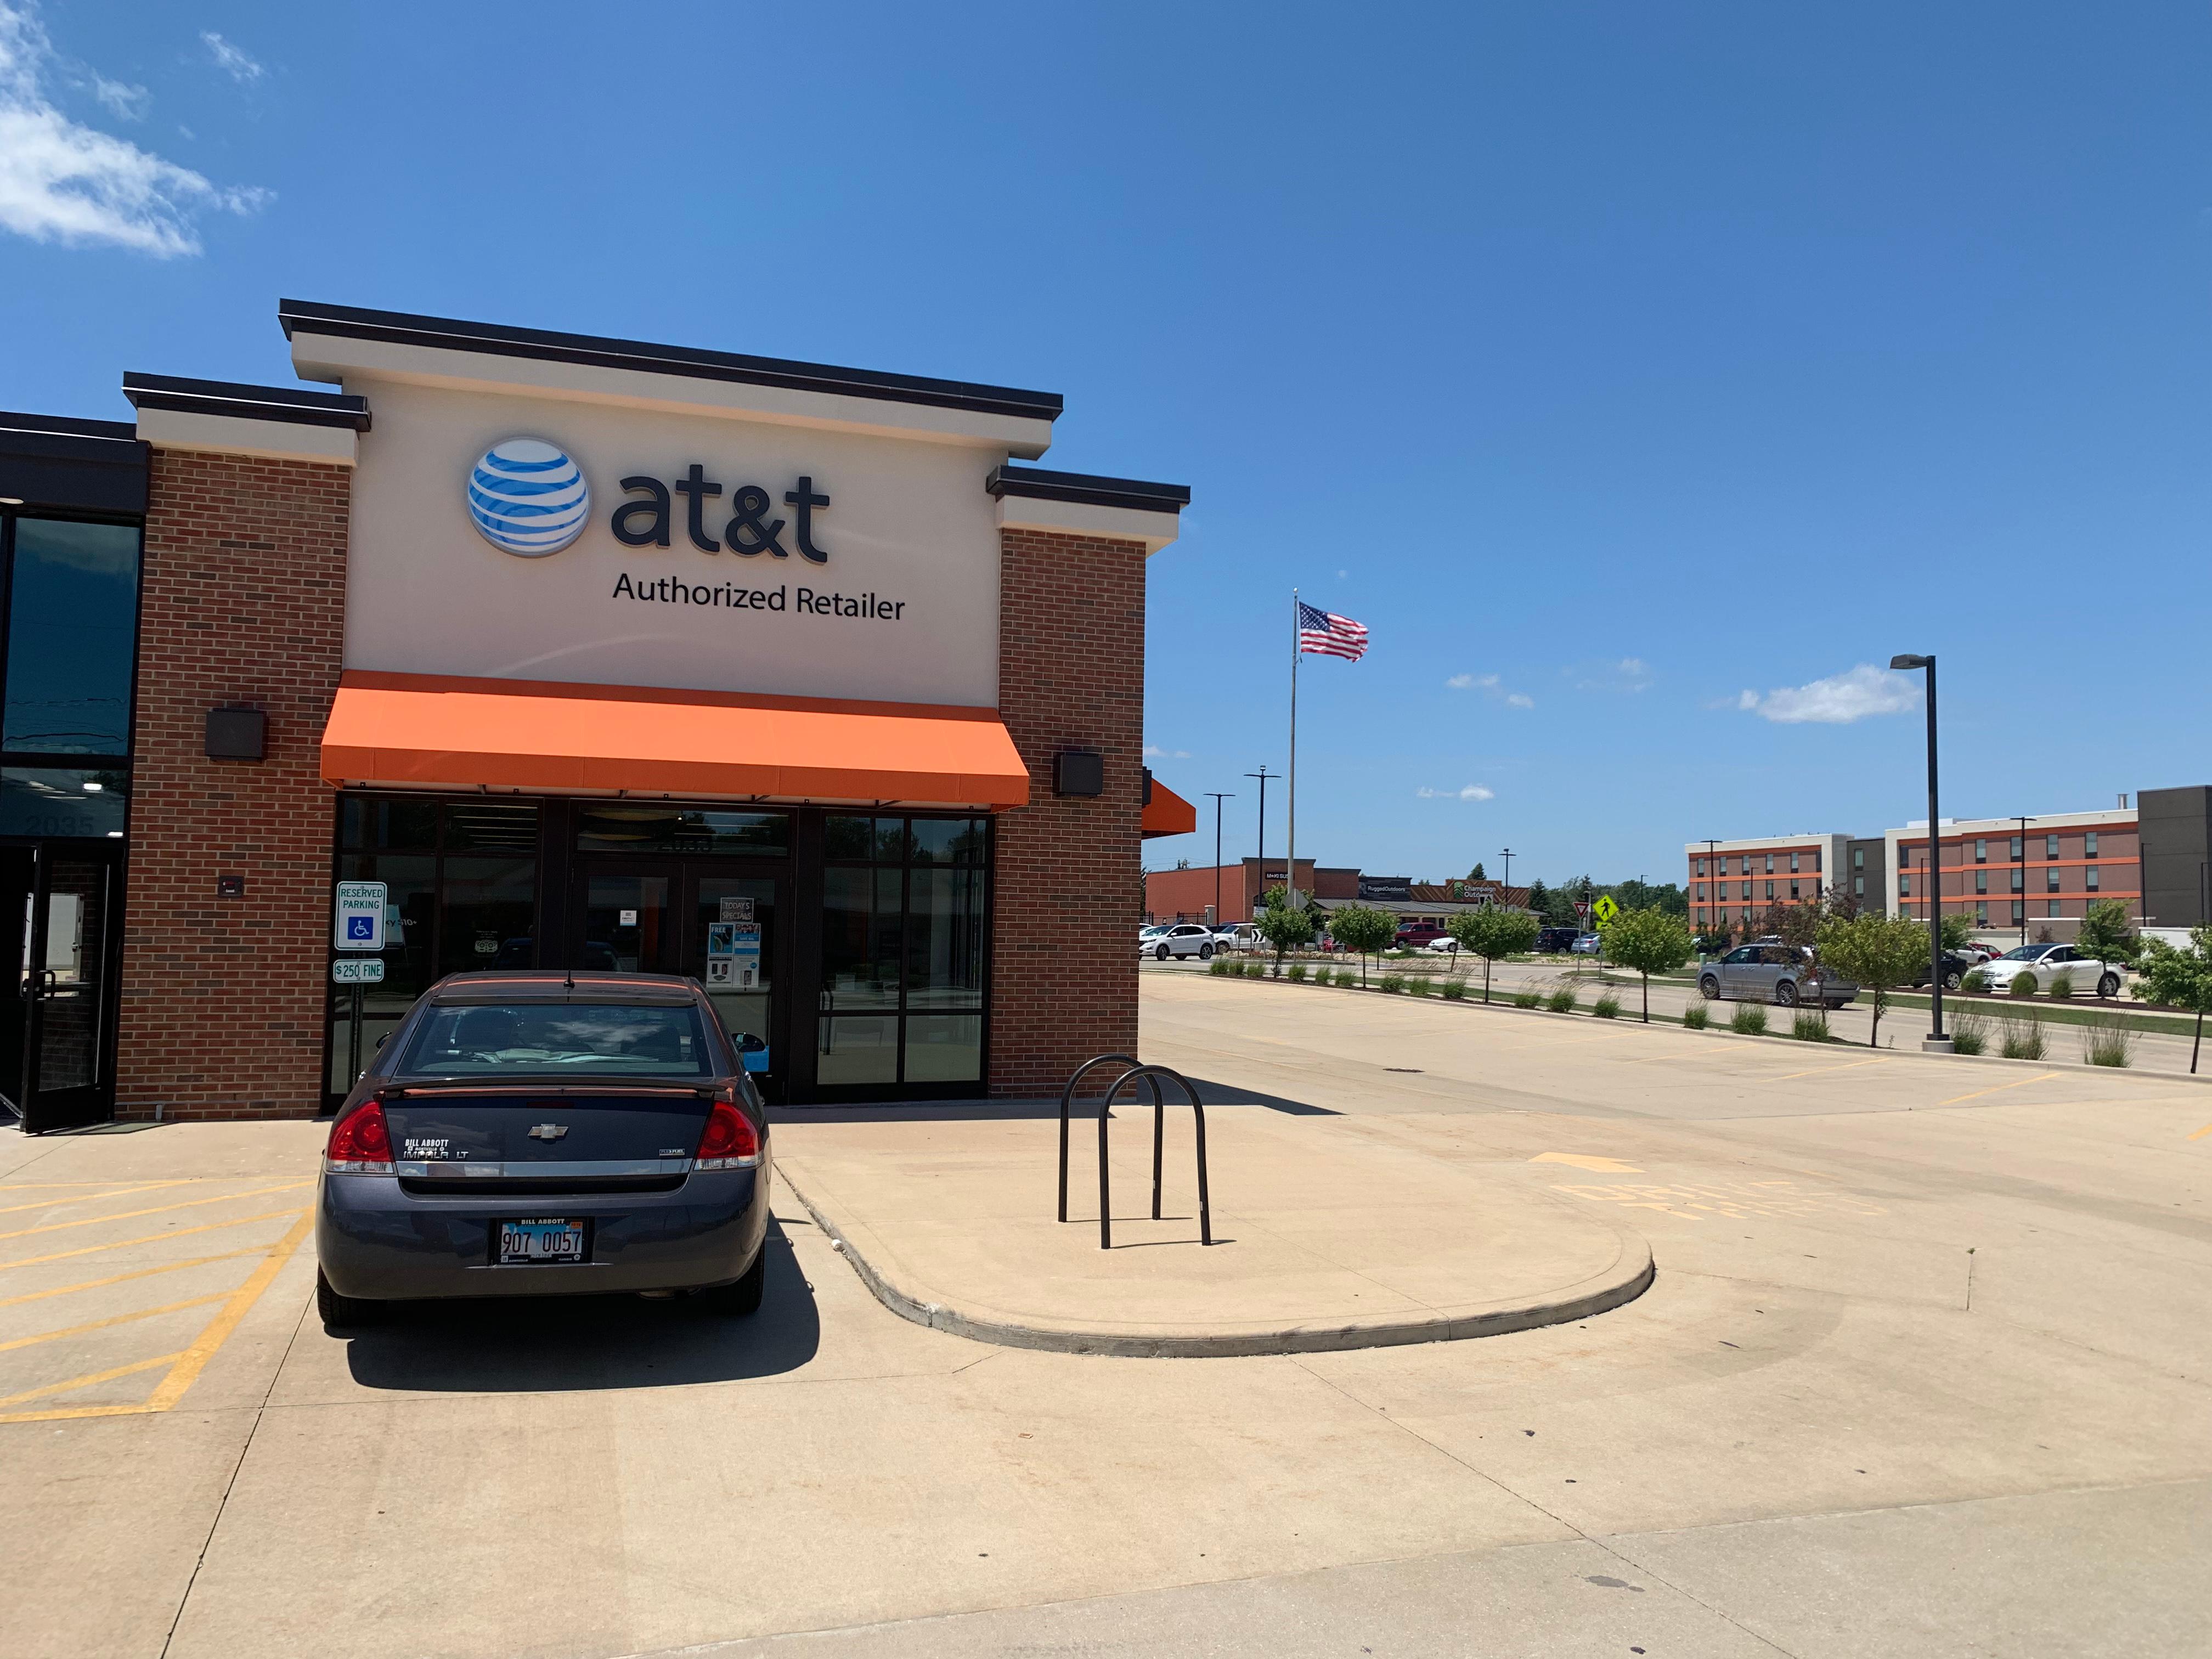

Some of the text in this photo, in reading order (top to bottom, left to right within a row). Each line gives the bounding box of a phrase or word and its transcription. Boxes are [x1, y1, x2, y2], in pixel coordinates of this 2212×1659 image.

[611, 464, 831, 565] at&t
[613, 573, 906, 620] Authorized Retailer
[341, 889, 382, 898] RESERVED
[1464, 885, 1496, 893] Champaign
[343, 900, 380, 909] PARKING
[722, 912, 752, 920] SPECIALS
[336, 964, 381, 977] $250 FINE
[503, 1232, 581, 1253] 907 0057
